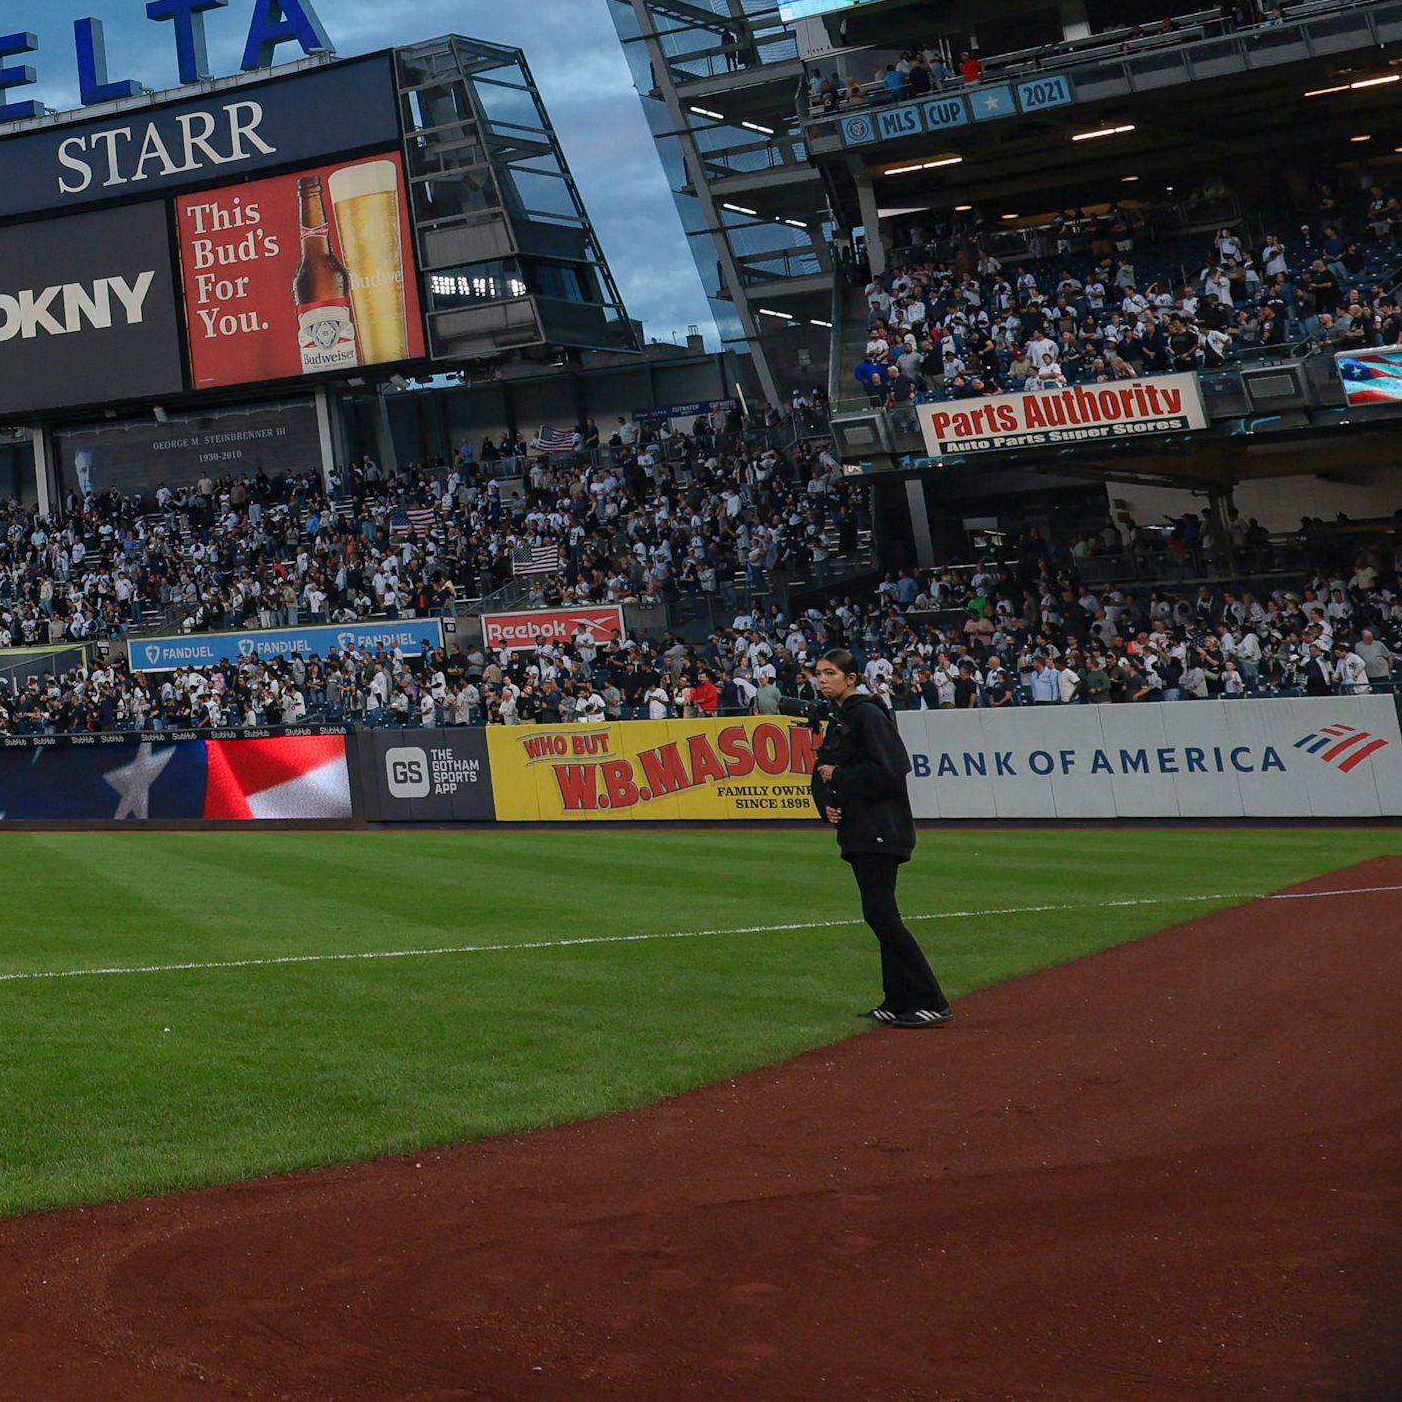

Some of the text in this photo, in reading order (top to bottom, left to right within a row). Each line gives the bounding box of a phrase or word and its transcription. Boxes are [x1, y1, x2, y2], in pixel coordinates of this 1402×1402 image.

[1023, 80, 1065, 107] 2021
[929, 102, 961, 125] CUP
[883, 111, 915, 135] MLS
[56, 100, 276, 195] STARR
[187, 197, 262, 234] This
[191, 228, 280, 270] Bud's
[195, 274, 251, 304] For
[197, 306, 270, 339] You.
[304, 349, 355, 365] Budweiser
[931, 383, 1182, 439] Parts Authority
[153, 438, 189, 451] GEORGE
[204, 428, 274, 445] STEINBRENNER
[946, 419, 1183, 453] Auto Parts Super Stores
[198, 450, 242, 463] 1930-2010
[487, 619, 567, 641] Reebok
[257, 639, 312, 654] FANDUEL
[357, 632, 417, 649] FANDUEL
[162, 645, 215, 659] FANDUEL
[101, 734, 124, 743] StubHub
[172, 731, 197, 740] StubHub
[211, 730, 236, 739] StubHub
[285, 727, 311, 736] StubHub
[319, 726, 346, 735] StubHub
[71, 736, 95, 745] StubHub
[522, 733, 609, 759] WHO BUT
[431, 749, 454, 760] THE
[912, 745, 1287, 778] BANK OF AMERICA
[392, 761, 423, 784] GS
[432, 759, 480, 772] GOTHAM
[433, 771, 478, 783] SPORTS
[435, 783, 458, 795] APP
[717, 785, 813, 798] FAMILY OWNE
[736, 798, 811, 809] SINCE 1898
